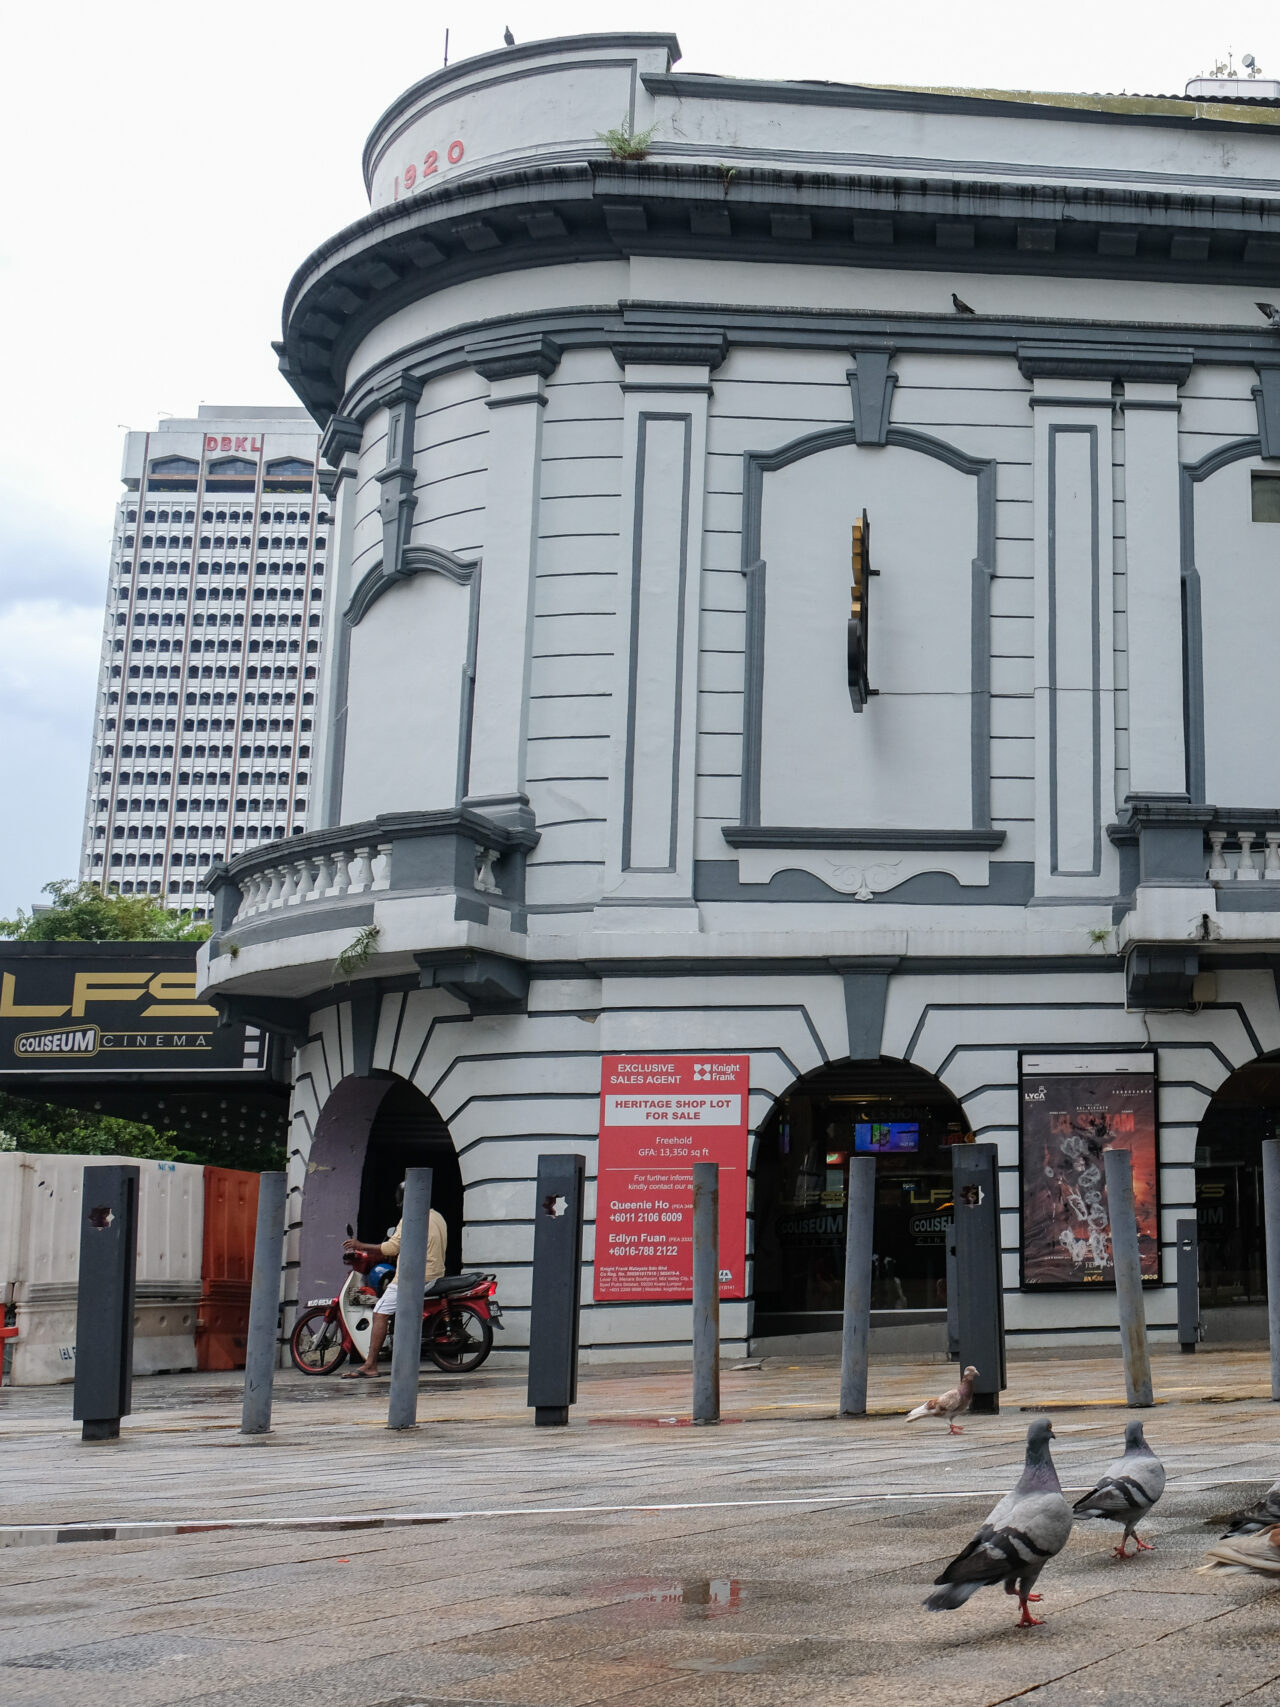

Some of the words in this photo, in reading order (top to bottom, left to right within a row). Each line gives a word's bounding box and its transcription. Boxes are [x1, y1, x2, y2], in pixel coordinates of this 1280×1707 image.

[394, 140, 464, 201] 1920
[206, 436, 261, 452] DBKL
[1, 972, 219, 1017] LFS
[19, 1030, 95, 1052] COLISEUM
[103, 1035, 206, 1047] CINEMA
[618, 1064, 675, 1072] EXCLUSIVE
[712, 1064, 740, 1073] Knight
[610, 1075, 644, 1084] SALES
[646, 1075, 682, 1083] AGENT
[713, 1073, 735, 1081] Frank
[615, 1100, 672, 1108] HERITAGE
[675, 1100, 706, 1108] SHOP
[710, 1100, 731, 1108] LOT
[646, 1112, 668, 1120] FOR
[672, 1112, 701, 1120] SALE
[656, 1136, 692, 1145] Freehold
[660, 1148, 688, 1157] 13,350
[702, 1148, 709, 1156] ft
[911, 1189, 952, 1204] LF
[610, 1200, 652, 1210] Queenie
[655, 1200, 669, 1209] Ho
[610, 1213, 635, 1222] +6011
[638, 1212, 659, 1222] 2106
[661, 1212, 682, 1222] 6009
[782, 1214, 843, 1233] COLISEUM
[913, 1216, 953, 1232] COLISE
[609, 1233, 638, 1244] Edlyn
[641, 1233, 666, 1242] Fuan
[609, 1246, 654, 1256] +6016-788
[656, 1246, 678, 1255] 2122
